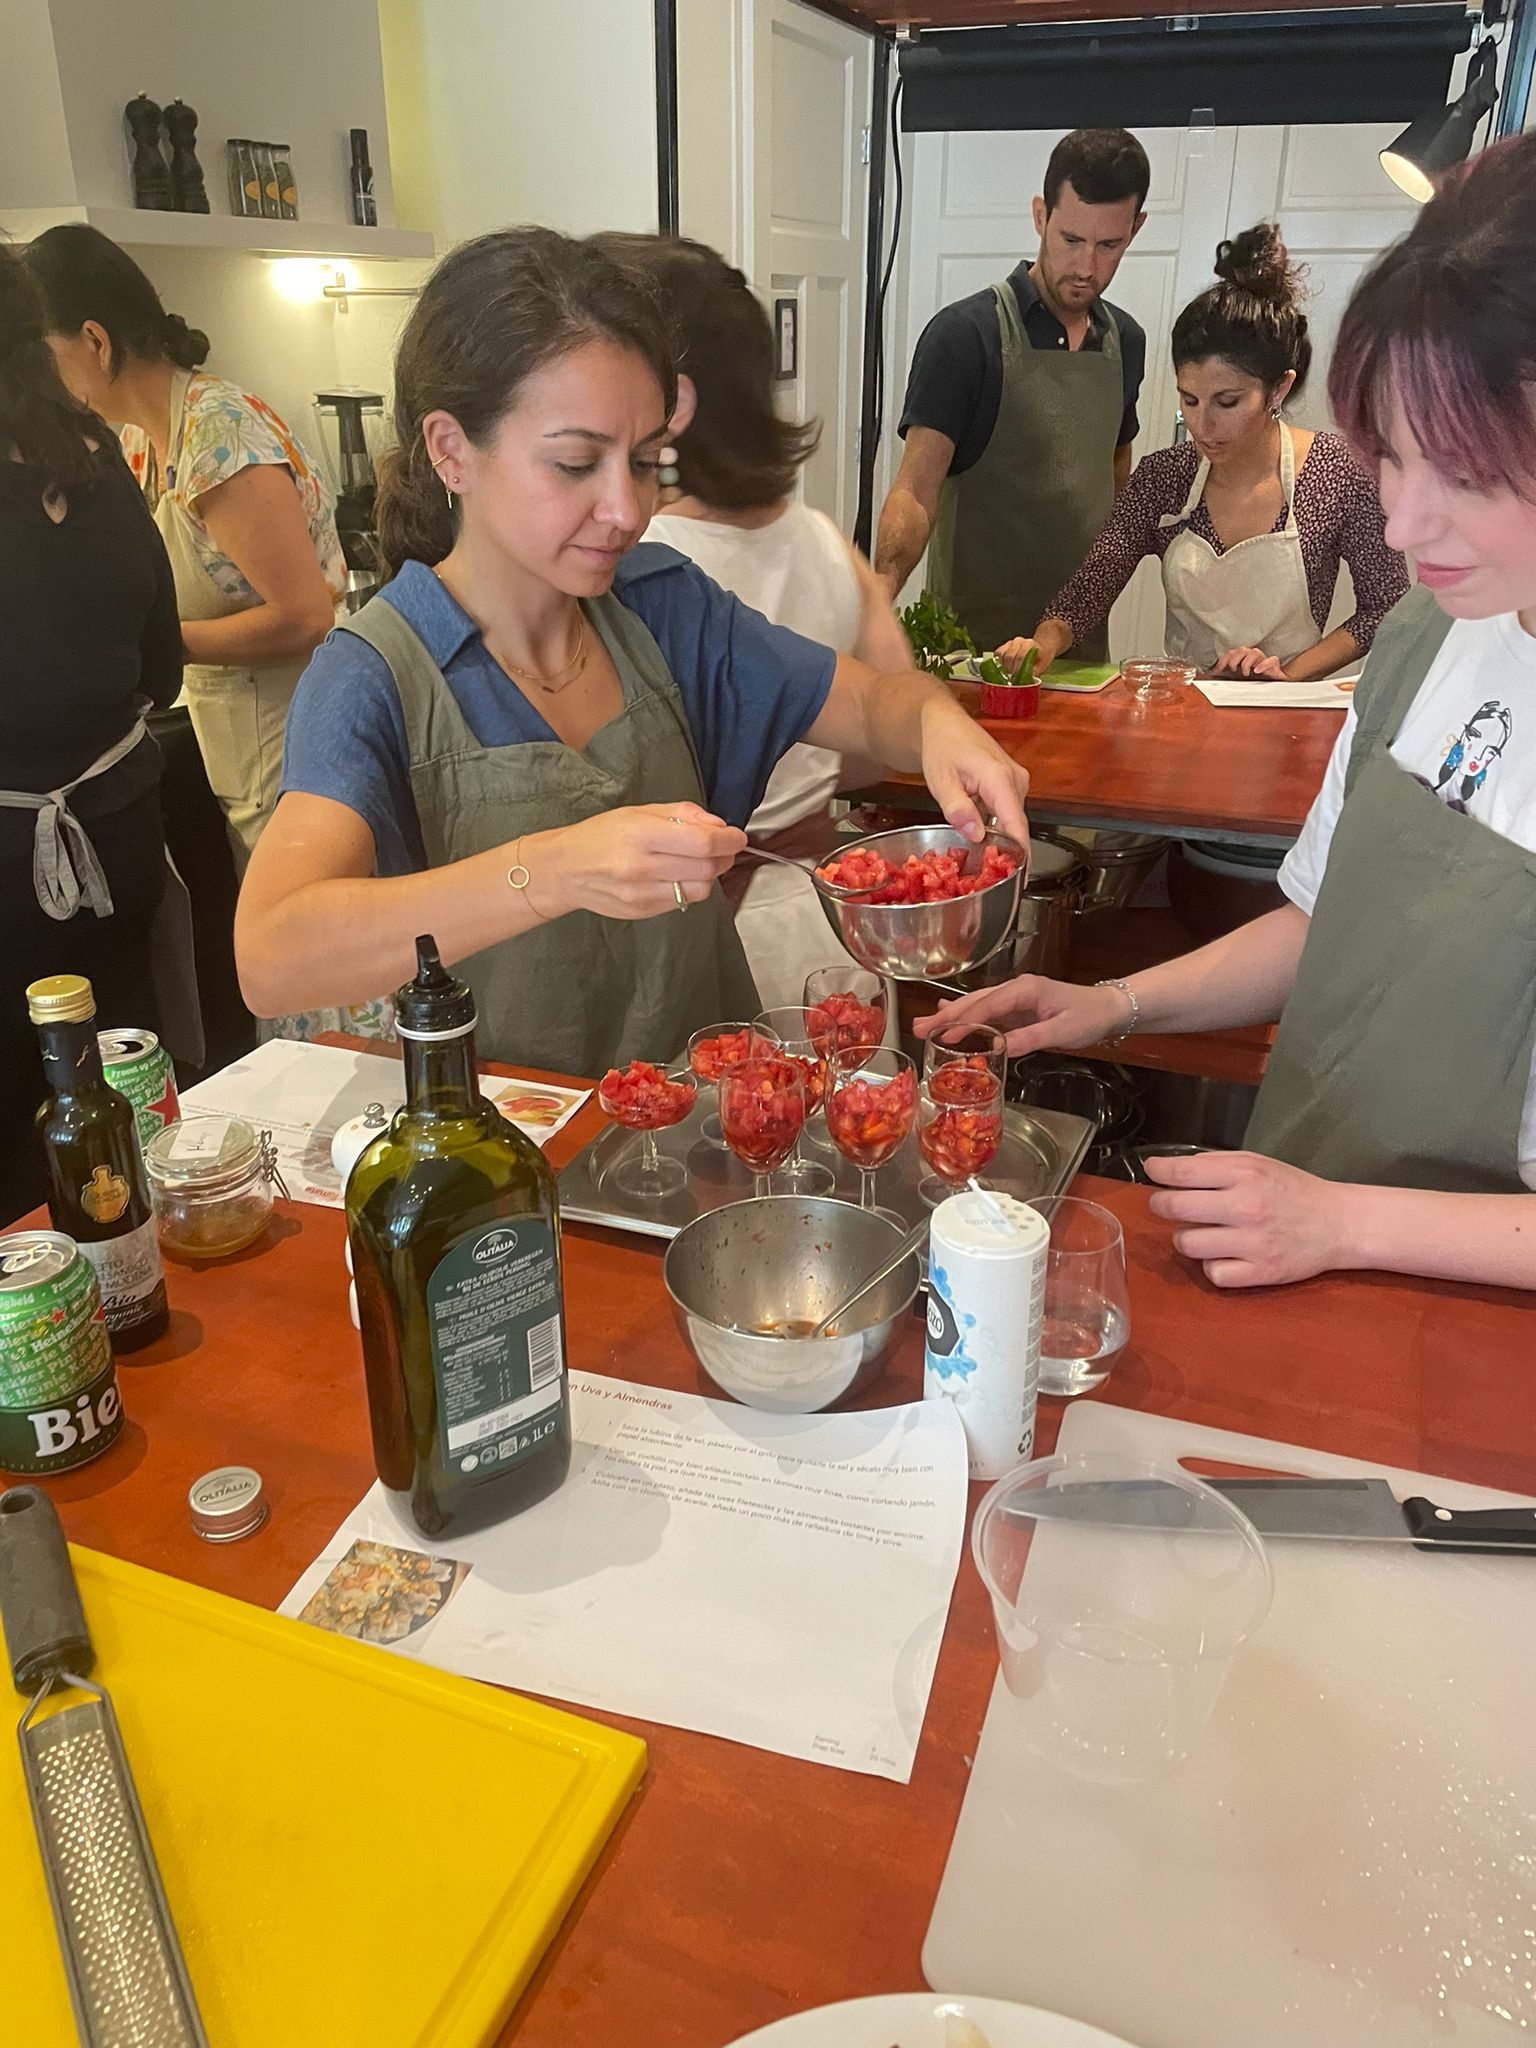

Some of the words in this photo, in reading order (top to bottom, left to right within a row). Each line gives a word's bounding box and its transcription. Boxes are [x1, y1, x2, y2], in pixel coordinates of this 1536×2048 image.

[475, 1240, 514, 1260] OLITALIA
[102, 1295, 137, 1308] Bio
[581, 1384, 601, 1396] Uva
[613, 1391, 673, 1410] Almendras
[27, 1387, 121, 1457] Bie
[532, 1427, 544, 1442] 1L
[673, 1432, 684, 1440] de
[882, 1467, 900, 1475] muy
[920, 1465, 934, 1473] con
[200, 1481, 252, 1502] OLITALIA
[804, 1486, 822, 1494] muy
[846, 1494, 870, 1502] como
[871, 1497, 908, 1507] cortando
[704, 1491, 715, 1499] las
[783, 1507, 795, 1516] las
[750, 1512, 772, 1521] poco
[842, 1529, 854, 1537] de
[875, 1537, 880, 1545] y
